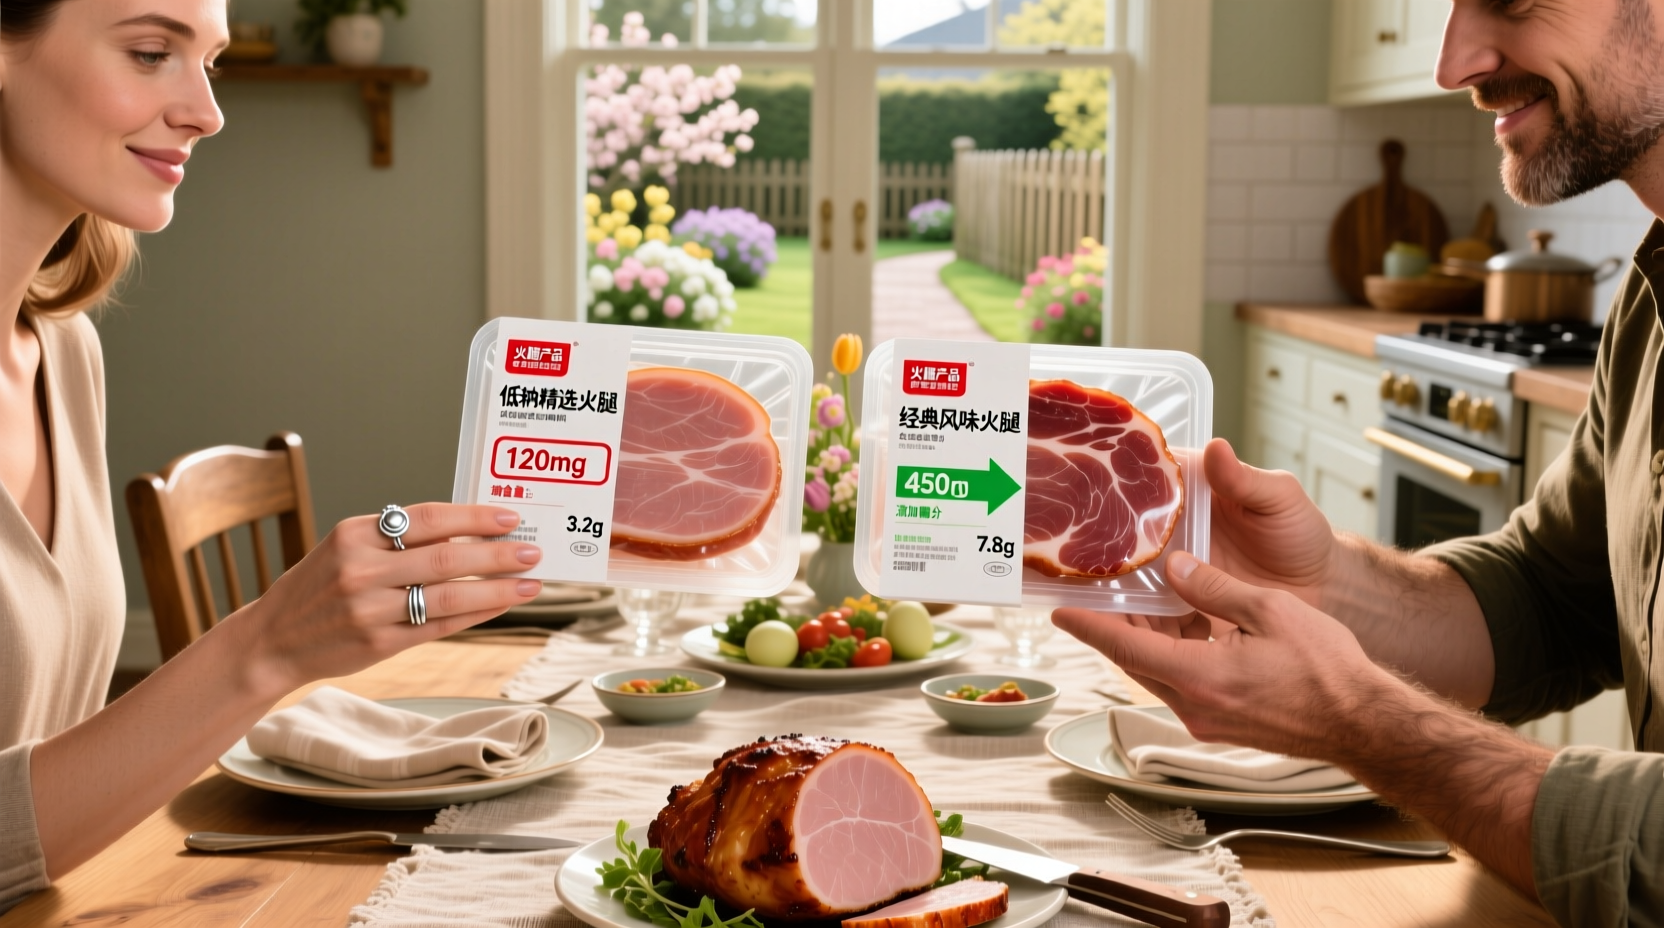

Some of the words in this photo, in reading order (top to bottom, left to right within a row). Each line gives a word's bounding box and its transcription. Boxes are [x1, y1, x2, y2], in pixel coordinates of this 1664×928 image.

[899, 405, 1021, 433] 经典风味火腿
[506, 446, 587, 479] 120mg
[566, 515, 604, 538] 3.2g
[976, 535, 1015, 559] 7.8g
